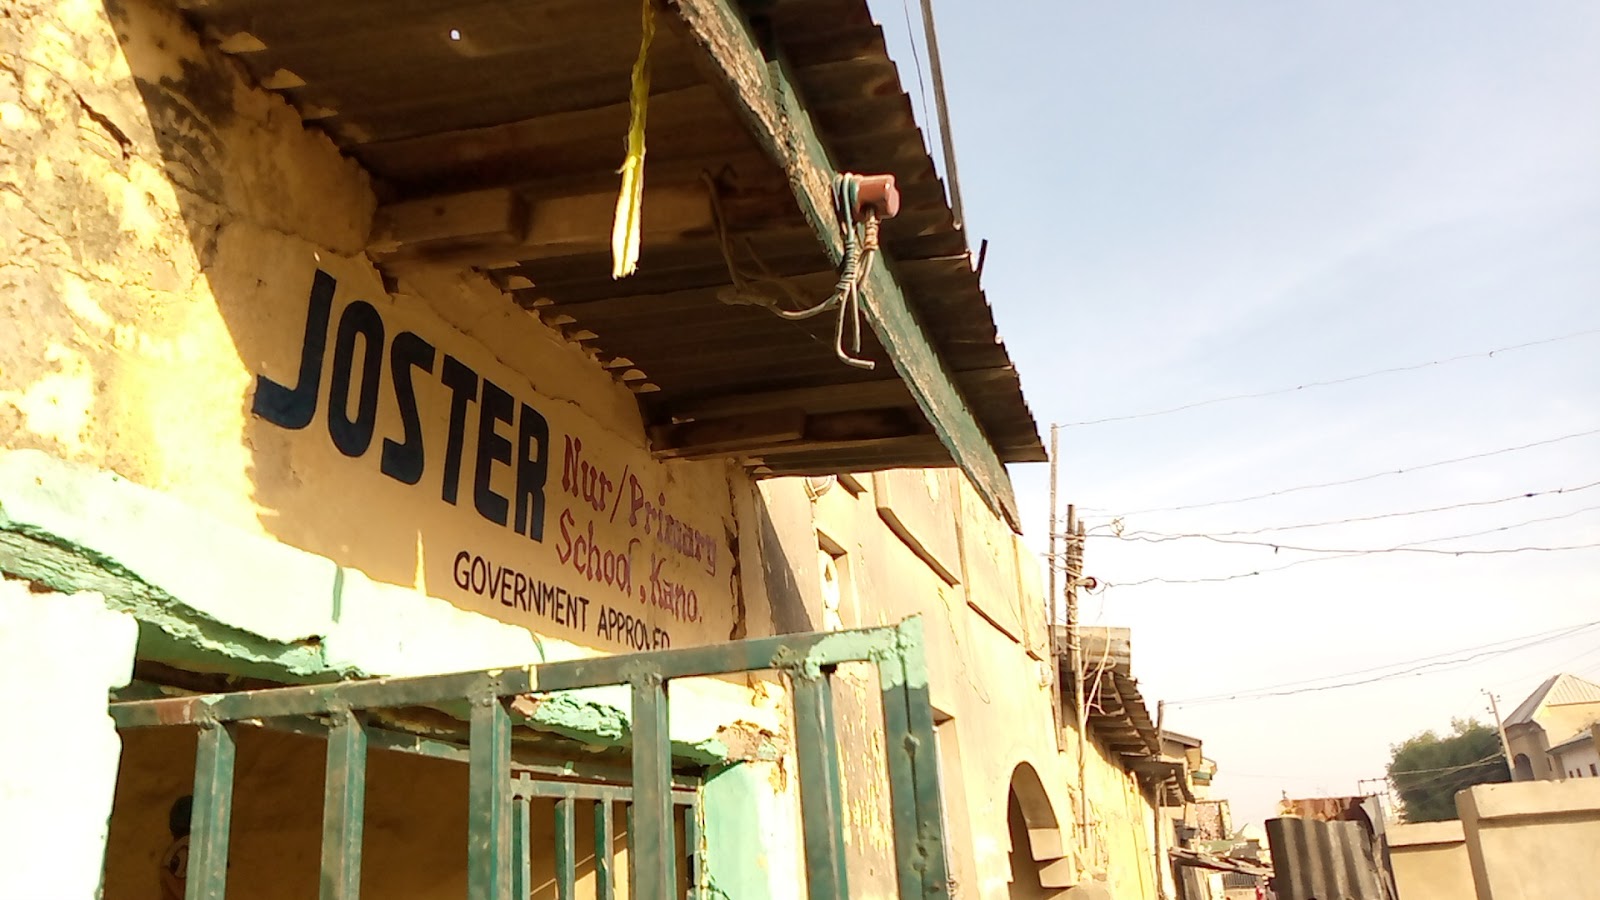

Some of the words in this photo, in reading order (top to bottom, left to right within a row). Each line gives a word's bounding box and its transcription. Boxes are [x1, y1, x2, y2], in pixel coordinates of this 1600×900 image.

[251, 267, 549, 543] JOSTER
[562, 434, 717, 577] Nur/Primary
[453, 550, 590, 632] GOVERNMENT
